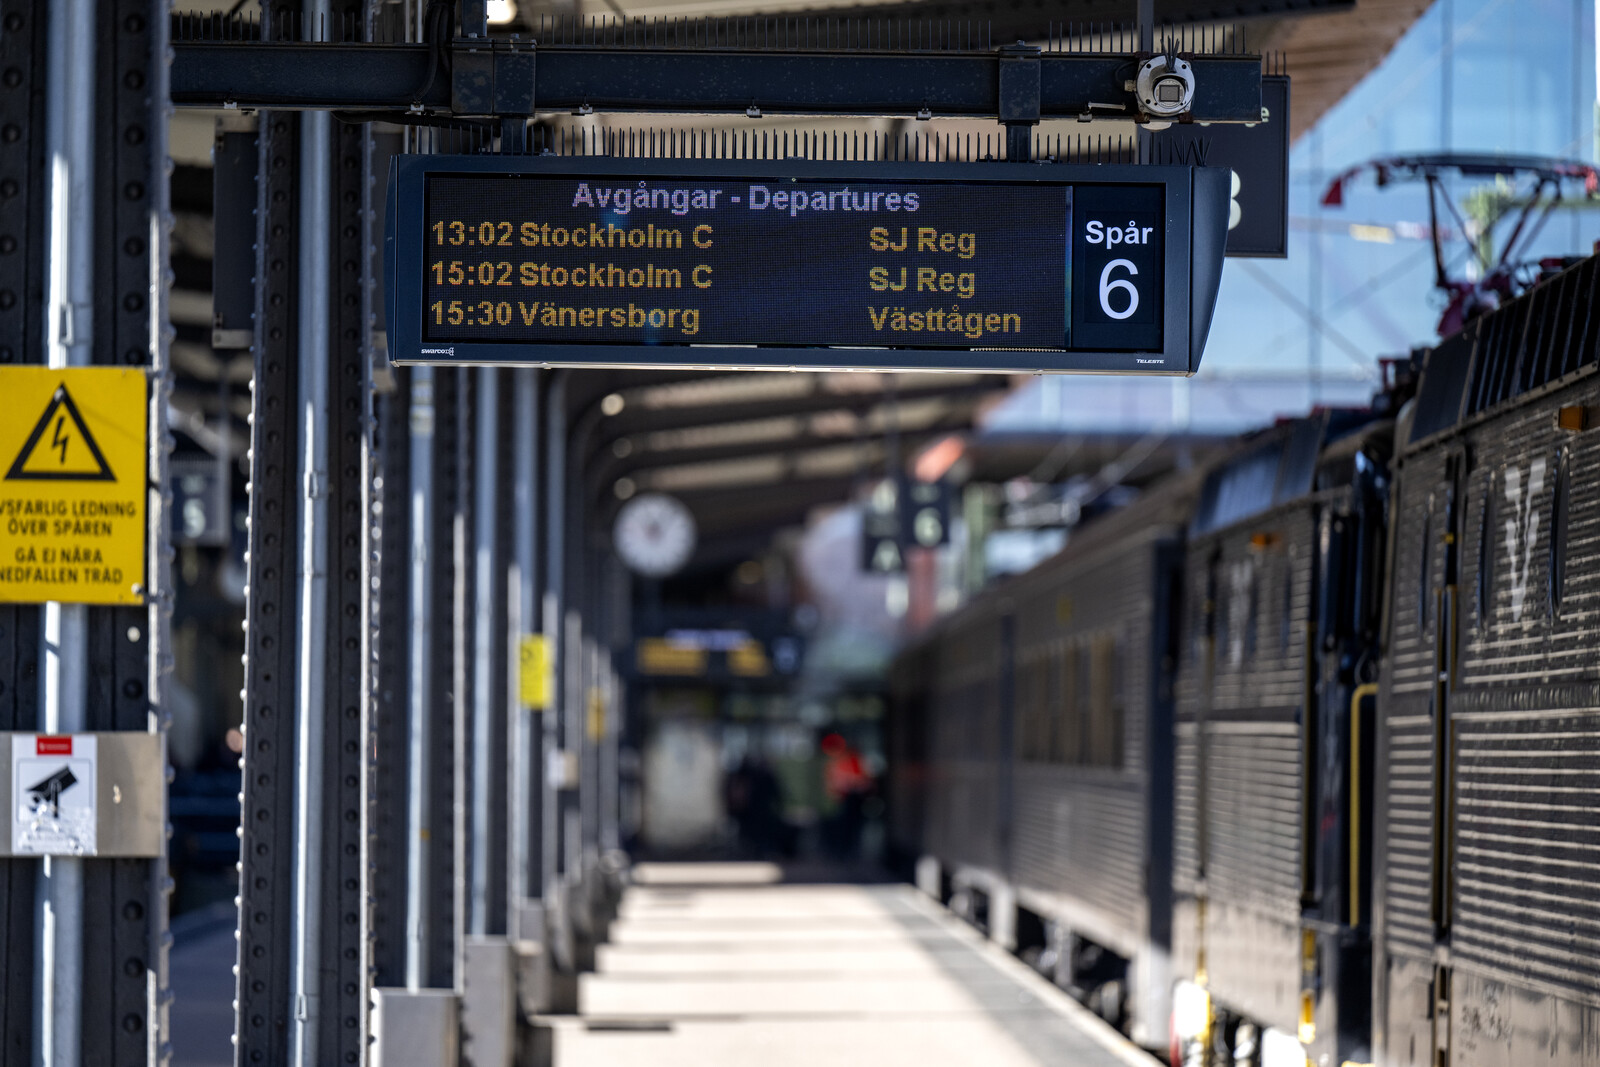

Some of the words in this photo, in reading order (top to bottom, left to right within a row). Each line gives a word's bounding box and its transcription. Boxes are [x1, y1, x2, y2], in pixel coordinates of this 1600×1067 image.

[571, 181, 722, 215] Avgångar
[748, 184, 920, 217] Departures
[432, 220, 513, 246] 13:02
[520, 221, 682, 249] Stockholm
[692, 224, 713, 249] C
[869, 226, 908, 252] SJ
[918, 227, 976, 259] Reg
[1085, 220, 1154, 250] Spår
[431, 260, 513, 286] 15:02
[519, 261, 682, 288] Stockholm
[692, 264, 713, 289] C
[869, 266, 907, 292] SJ
[917, 267, 975, 299] Reg
[1098, 258, 1140, 320] 6
[431, 300, 512, 326] 15:30
[518, 301, 700, 335] Vänersborg
[868, 304, 1021, 339] Västtågen
[72, 500, 137, 518] LEDNING
[8, 518, 48, 535] ÖVER
[53, 518, 113, 537] SPÅREN
[14, 544, 37, 563] GÅ
[42, 548, 56, 563] EJ
[84, 566, 124, 584] TRÅD
